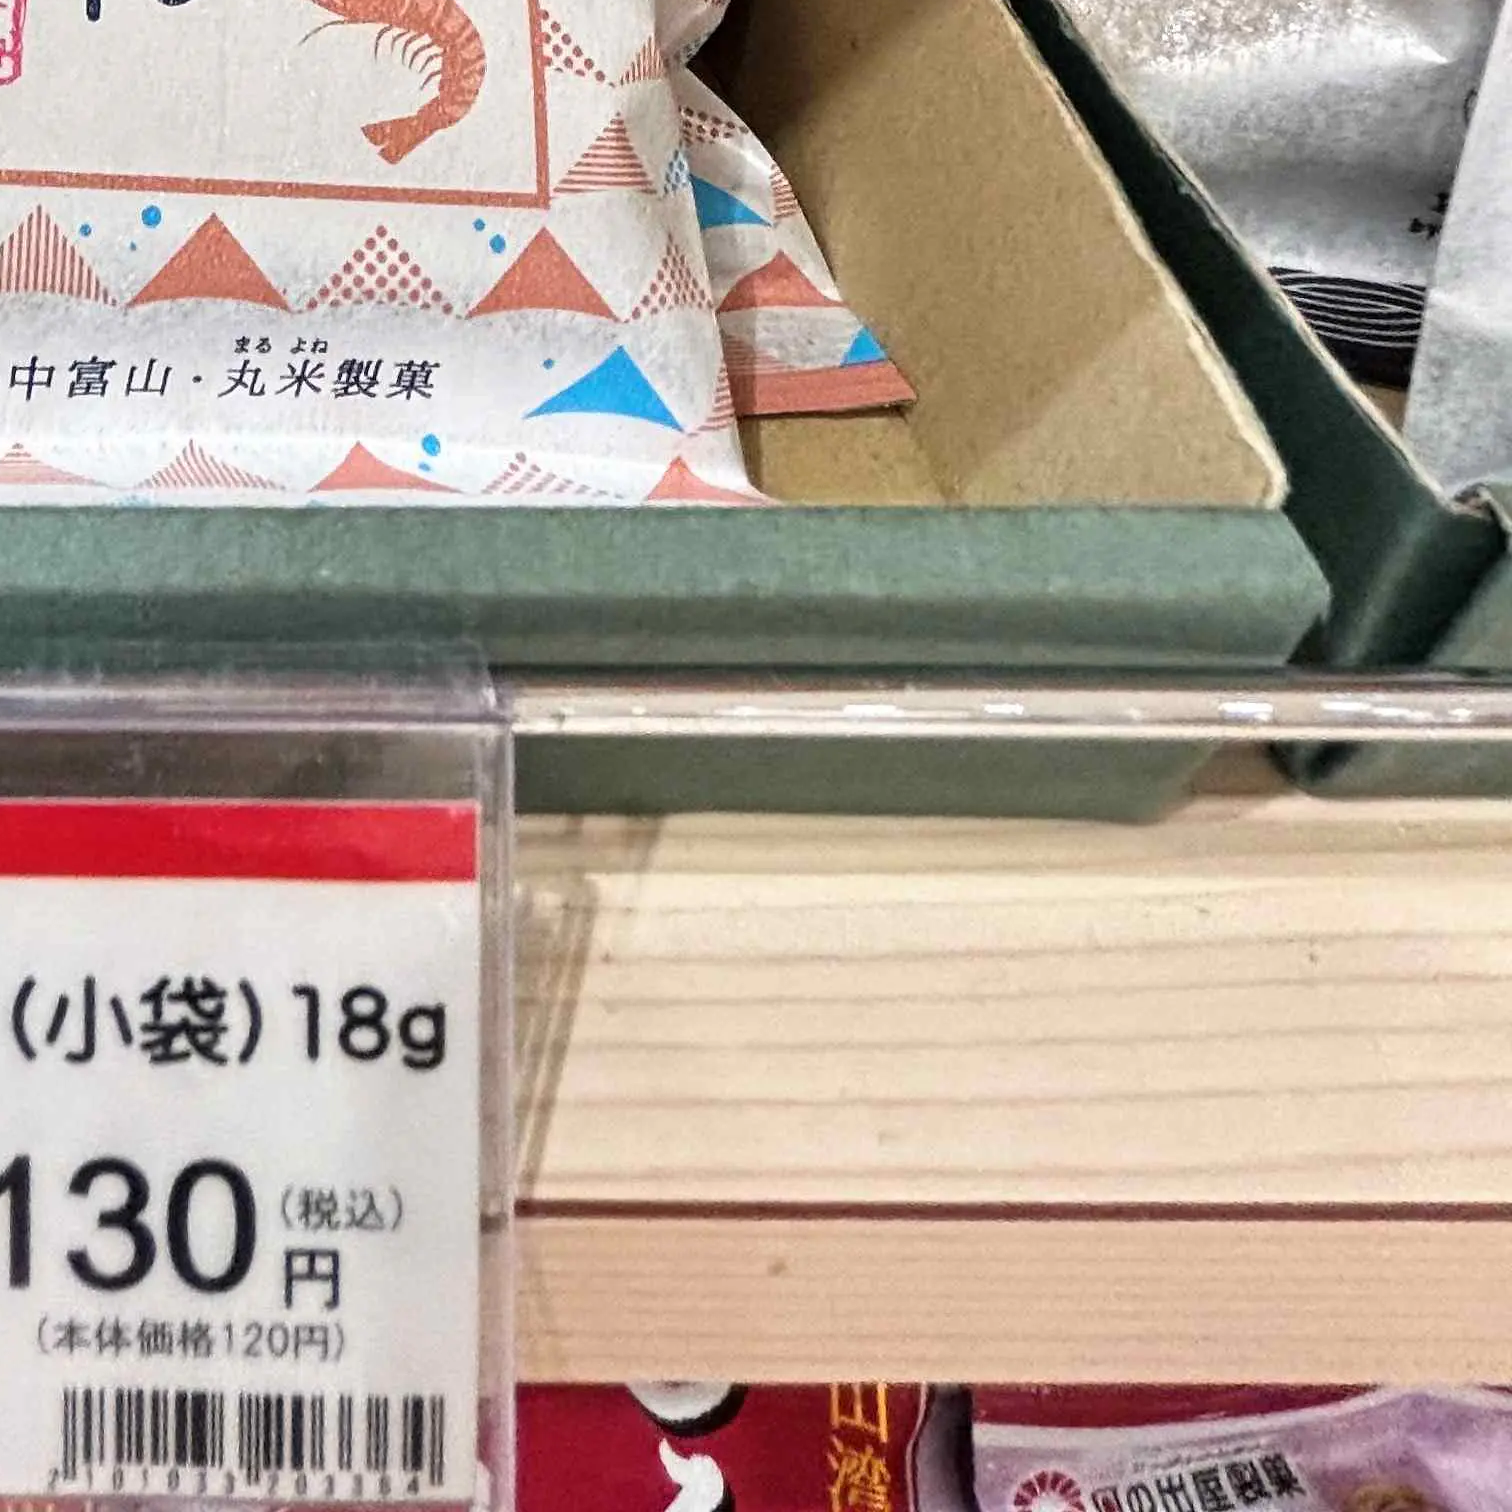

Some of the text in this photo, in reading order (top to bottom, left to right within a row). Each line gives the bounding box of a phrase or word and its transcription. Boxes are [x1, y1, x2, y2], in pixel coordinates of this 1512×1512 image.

[233, 336, 329, 354] まる よね
[281, 1189, 404, 1231] （税込）
[285, 1248, 341, 1310] 円
[38, 1318, 346, 1360] （本体価格120円）
